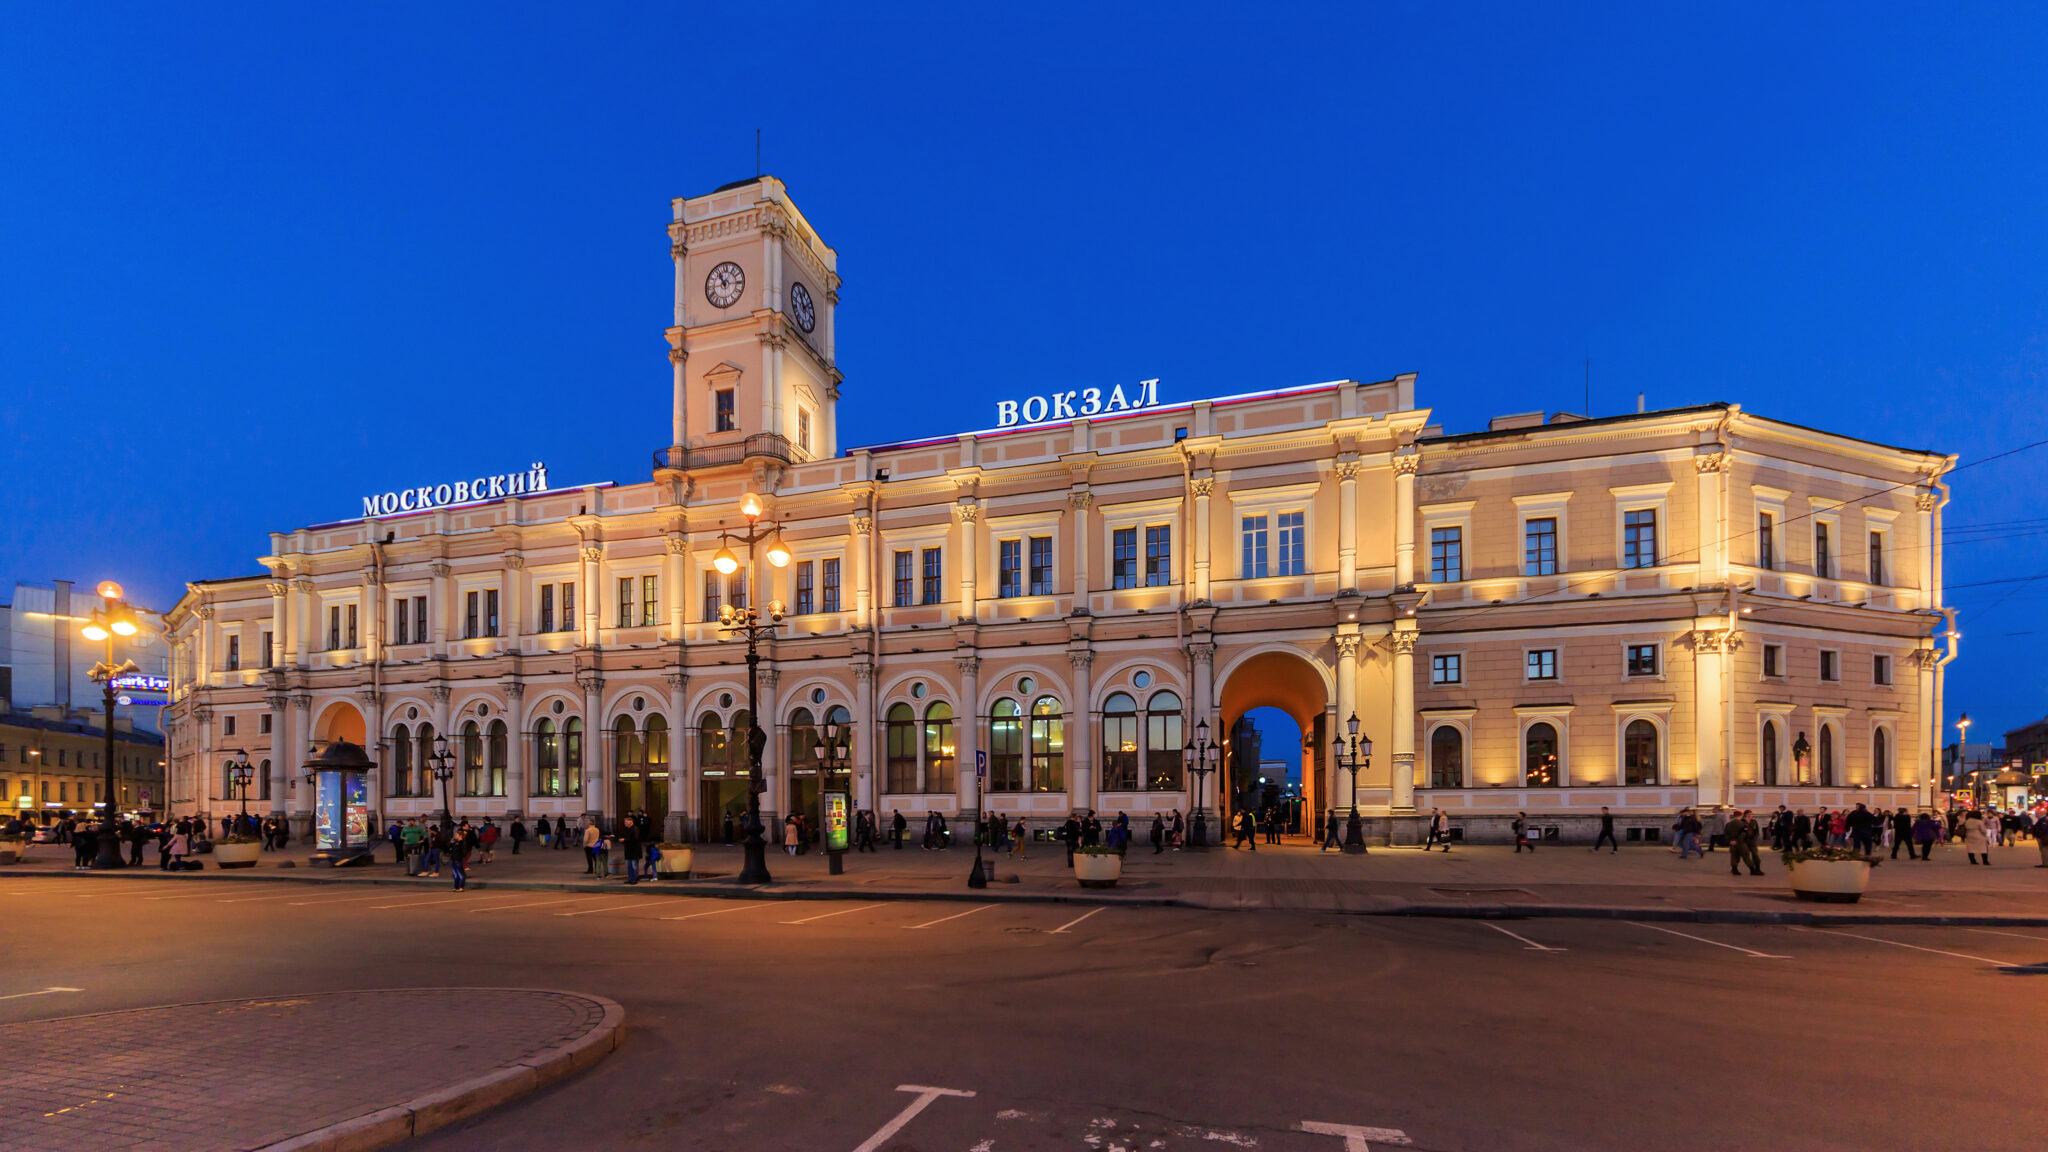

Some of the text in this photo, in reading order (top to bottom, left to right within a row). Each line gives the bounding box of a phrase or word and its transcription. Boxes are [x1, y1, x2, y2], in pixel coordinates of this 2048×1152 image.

[996, 378, 1160, 428] ВОКЗАЛ
[362, 461, 548, 518] МОСКОВСКИЙ
[978, 753, 985, 774] P
